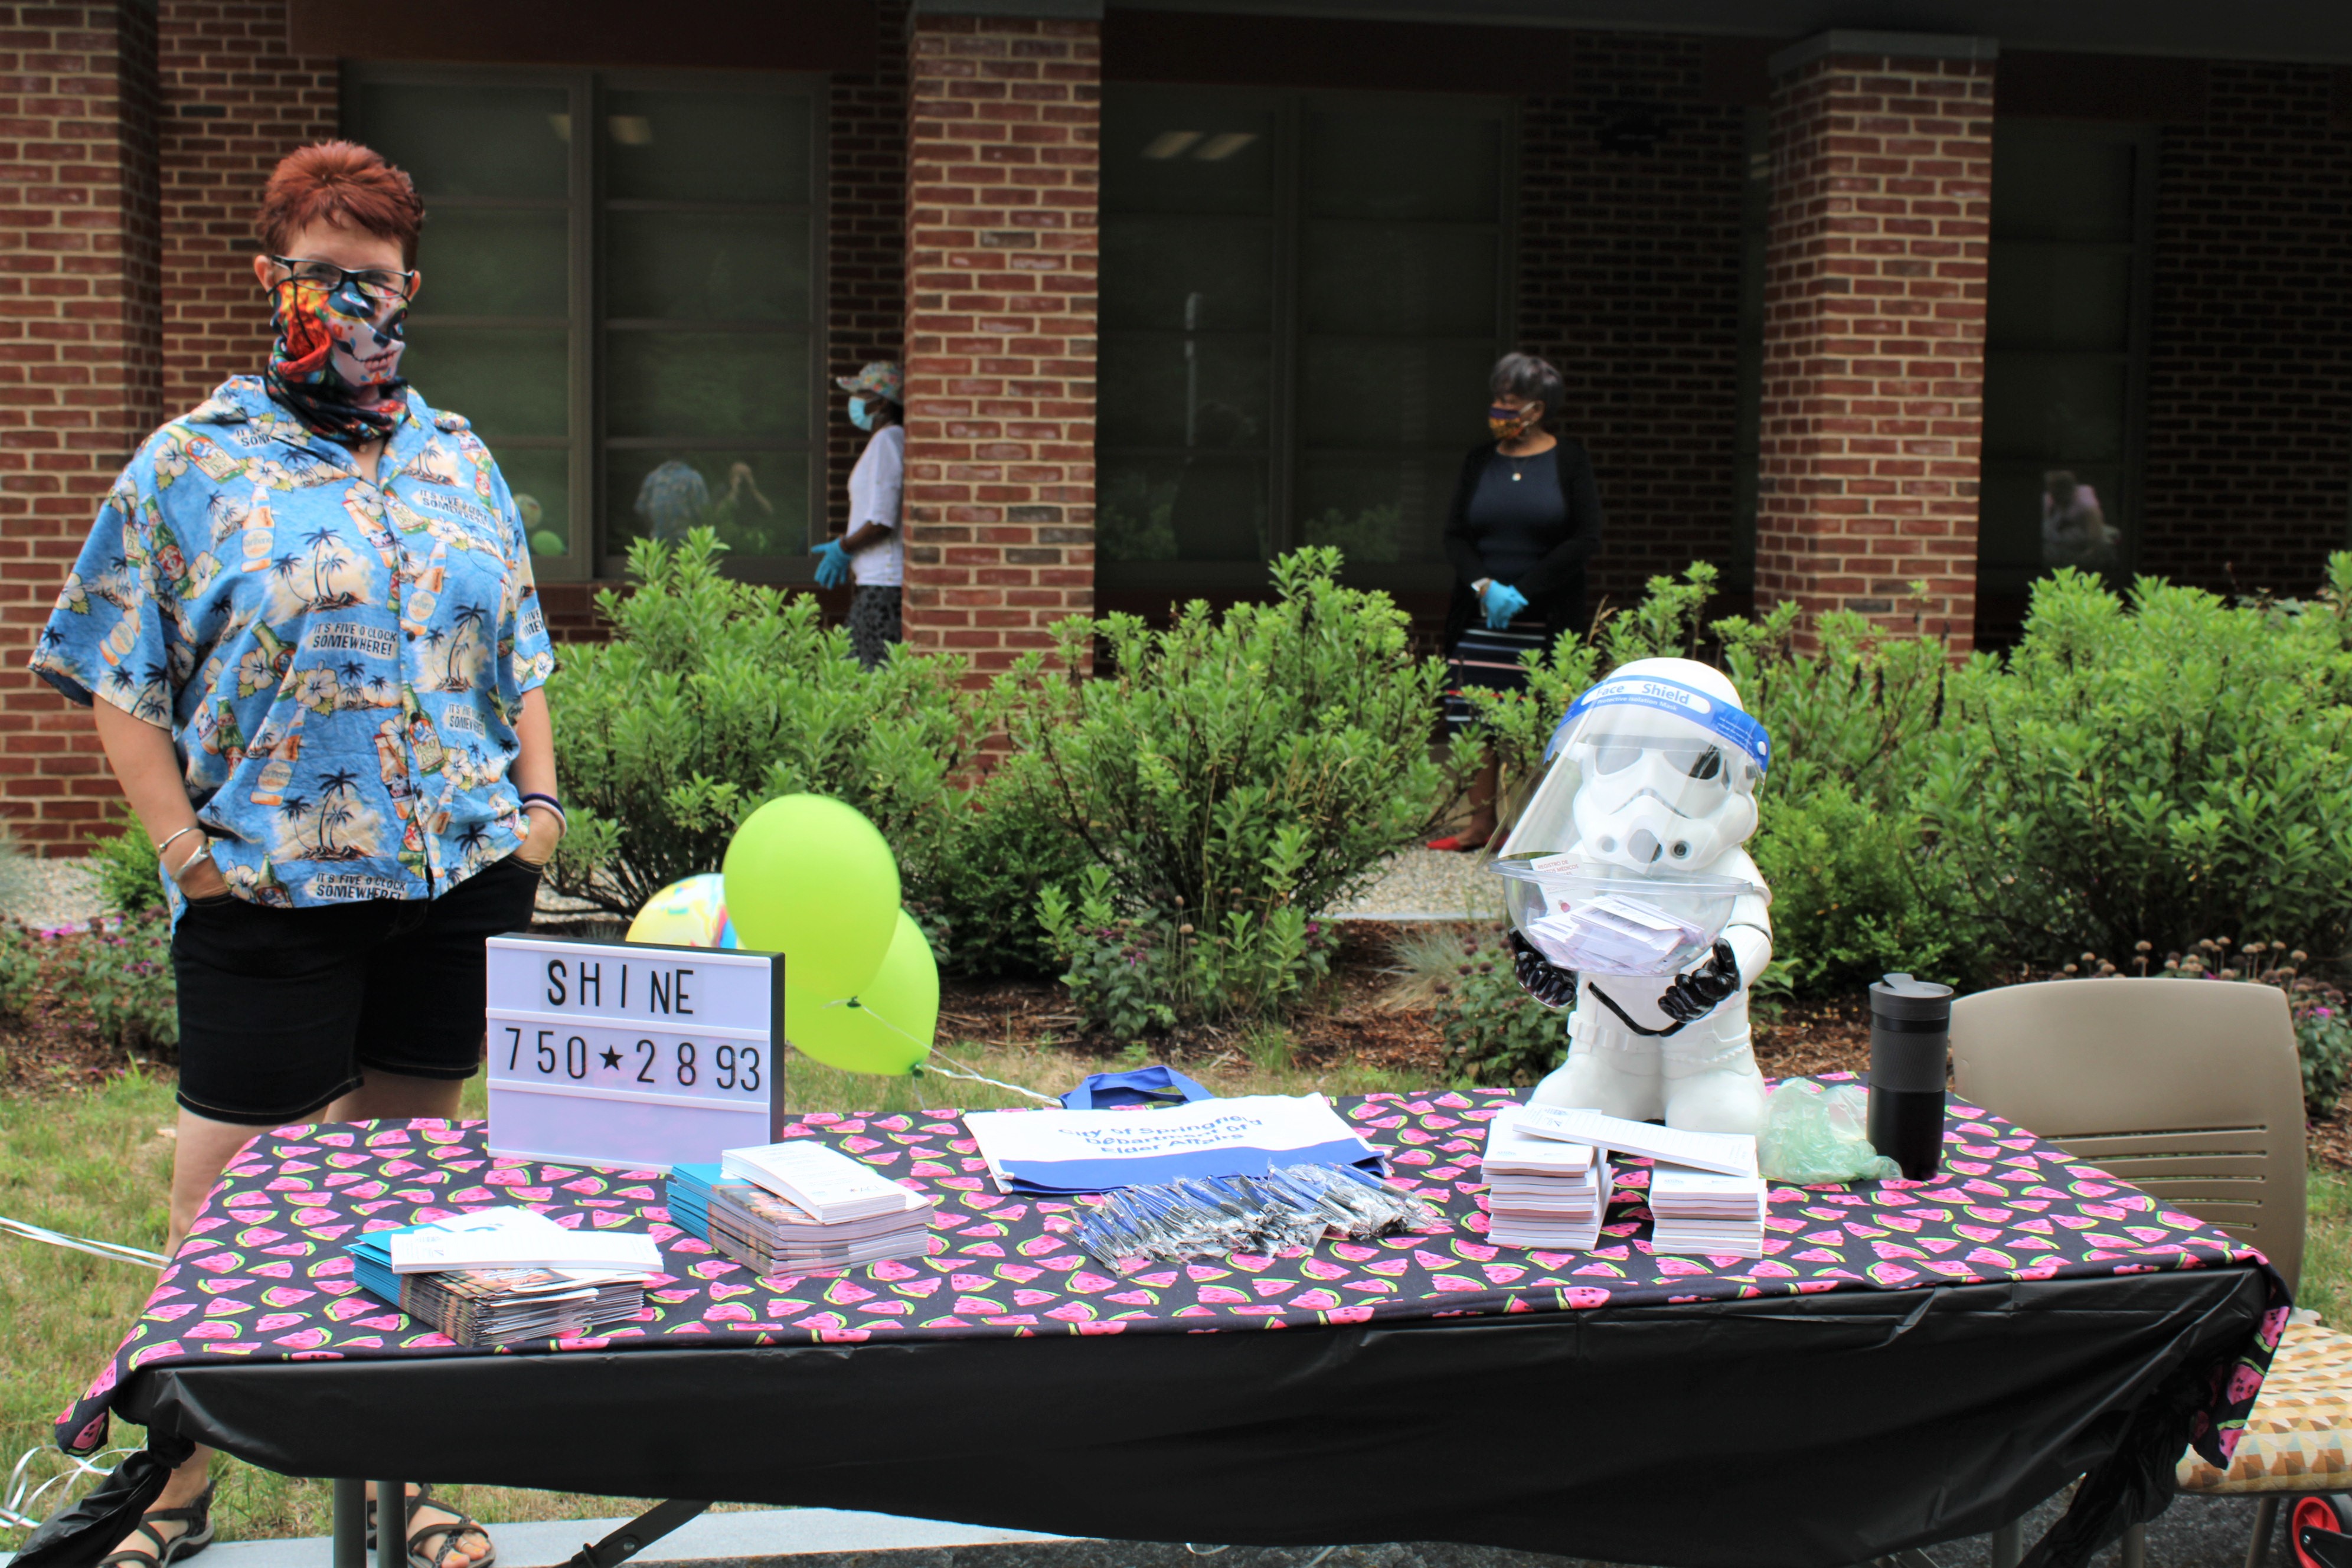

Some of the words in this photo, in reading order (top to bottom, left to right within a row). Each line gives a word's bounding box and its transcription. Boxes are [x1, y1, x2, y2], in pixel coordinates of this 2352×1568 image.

[314, 623, 331, 633] IT'S
[335, 623, 356, 635] FIVE
[359, 626, 397, 642] O'CLOCK
[313, 635, 393, 656] SOMEWHERE!
[1596, 685, 1624, 697] Face
[1642, 684, 1690, 705] Shield
[1659, 701, 1678, 711] Mask
[316, 873, 335, 883] IT'S
[339, 874, 362, 885] FIVE
[366, 876, 406, 891] O'CLOCK
[547, 959, 694, 1015] SHINE
[1058, 1129, 1102, 1138] City
[1139, 1115, 1263, 1134] Springfield
[1100, 1144, 1161, 1154] Elder
[1168, 1133, 1244, 1146] Affairs
